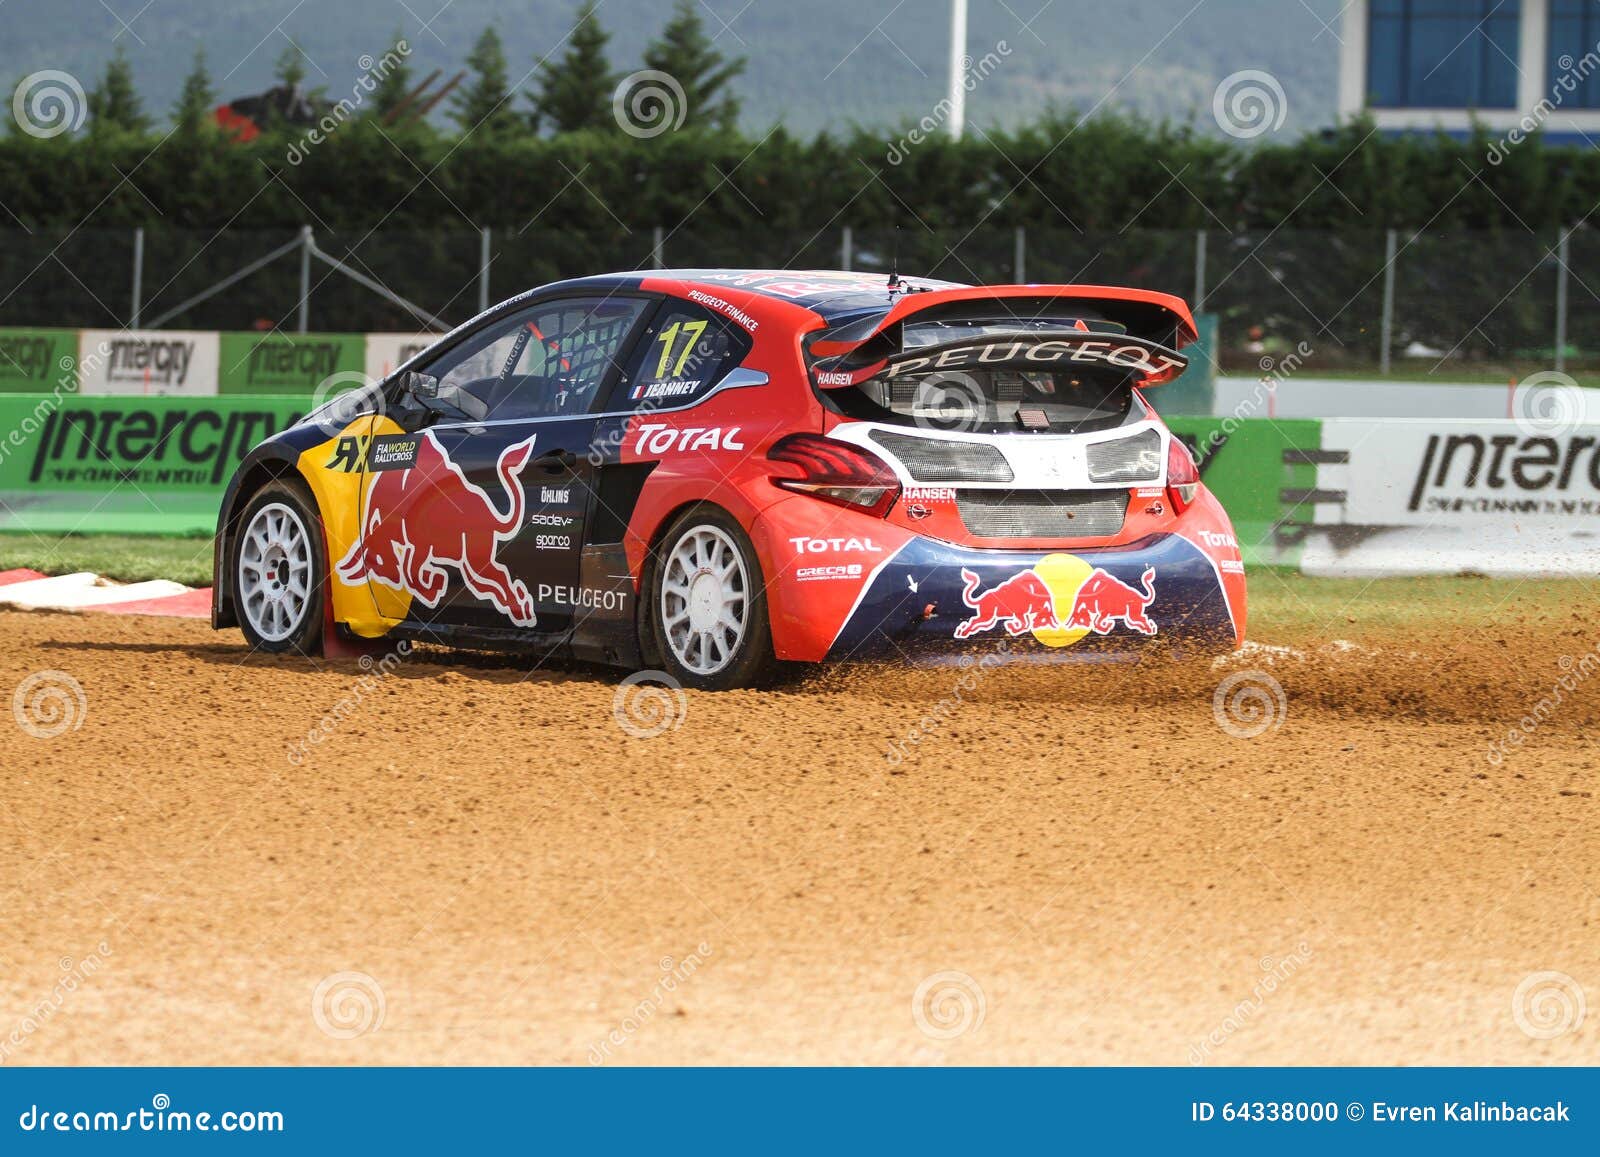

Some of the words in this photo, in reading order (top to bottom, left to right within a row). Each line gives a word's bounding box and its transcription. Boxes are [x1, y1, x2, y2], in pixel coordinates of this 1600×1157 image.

[687, 289, 726, 309] PEUGEOT
[724, 304, 759, 332] FINANCE
[655, 320, 708, 379] 17
[886, 340, 1187, 378] PEUGEOT
[817, 372, 854, 386] HANSEN
[643, 380, 701, 398] JEANNEY
[635, 423, 744, 455] TOTAL
[374, 451, 413, 464] RALLYCROSS
[902, 487, 957, 500] HANSEN
[536, 534, 571, 550] sparco
[789, 536, 882, 554] TOTAL
[538, 583, 627, 611] PEUGEOT
